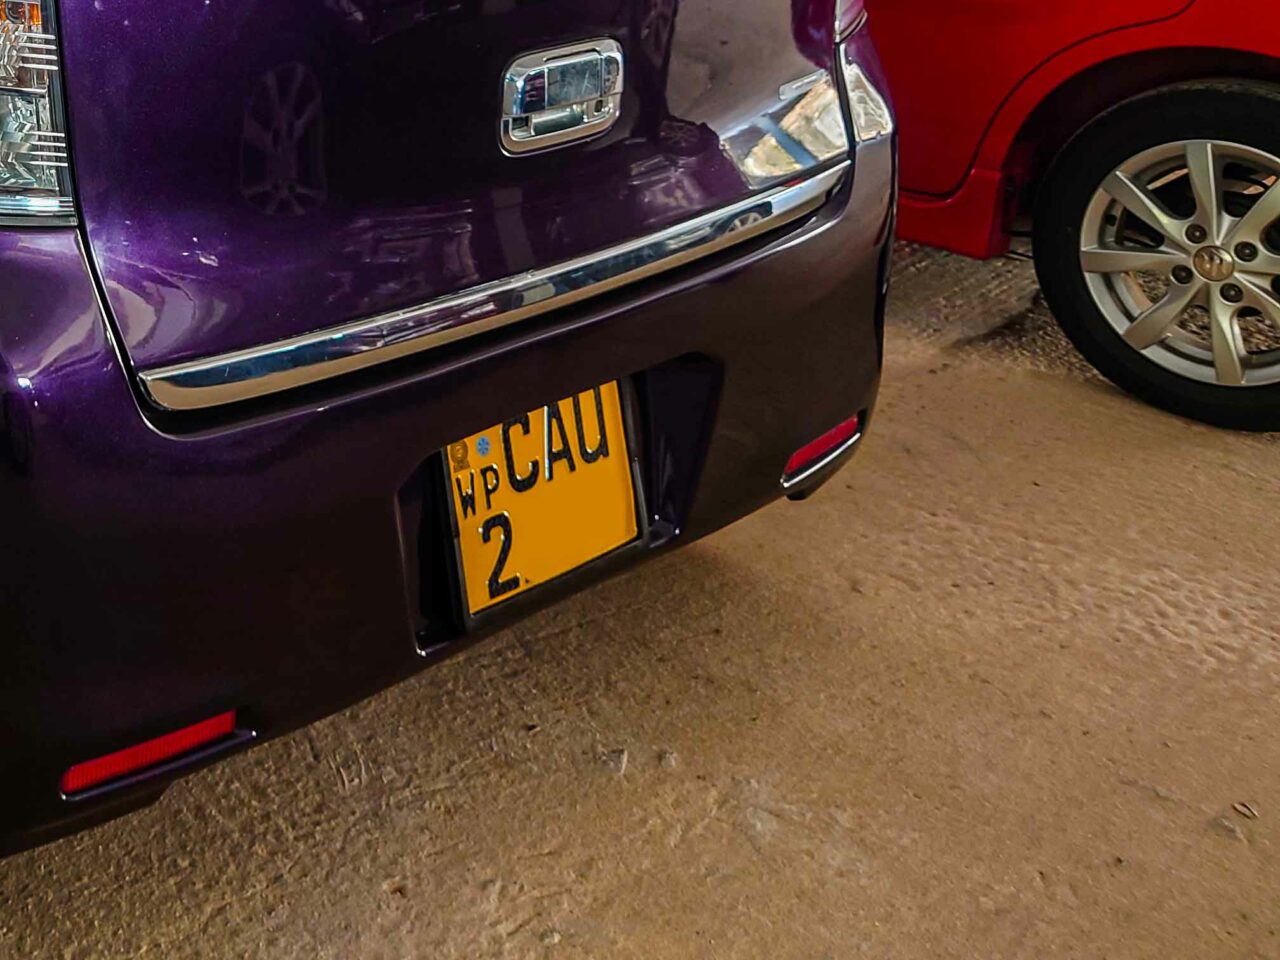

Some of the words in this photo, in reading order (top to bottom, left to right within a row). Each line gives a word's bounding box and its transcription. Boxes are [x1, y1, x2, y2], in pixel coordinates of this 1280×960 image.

[456, 464, 499, 519] WP
[502, 387, 609, 492] CAU
[481, 511, 520, 599] 2
